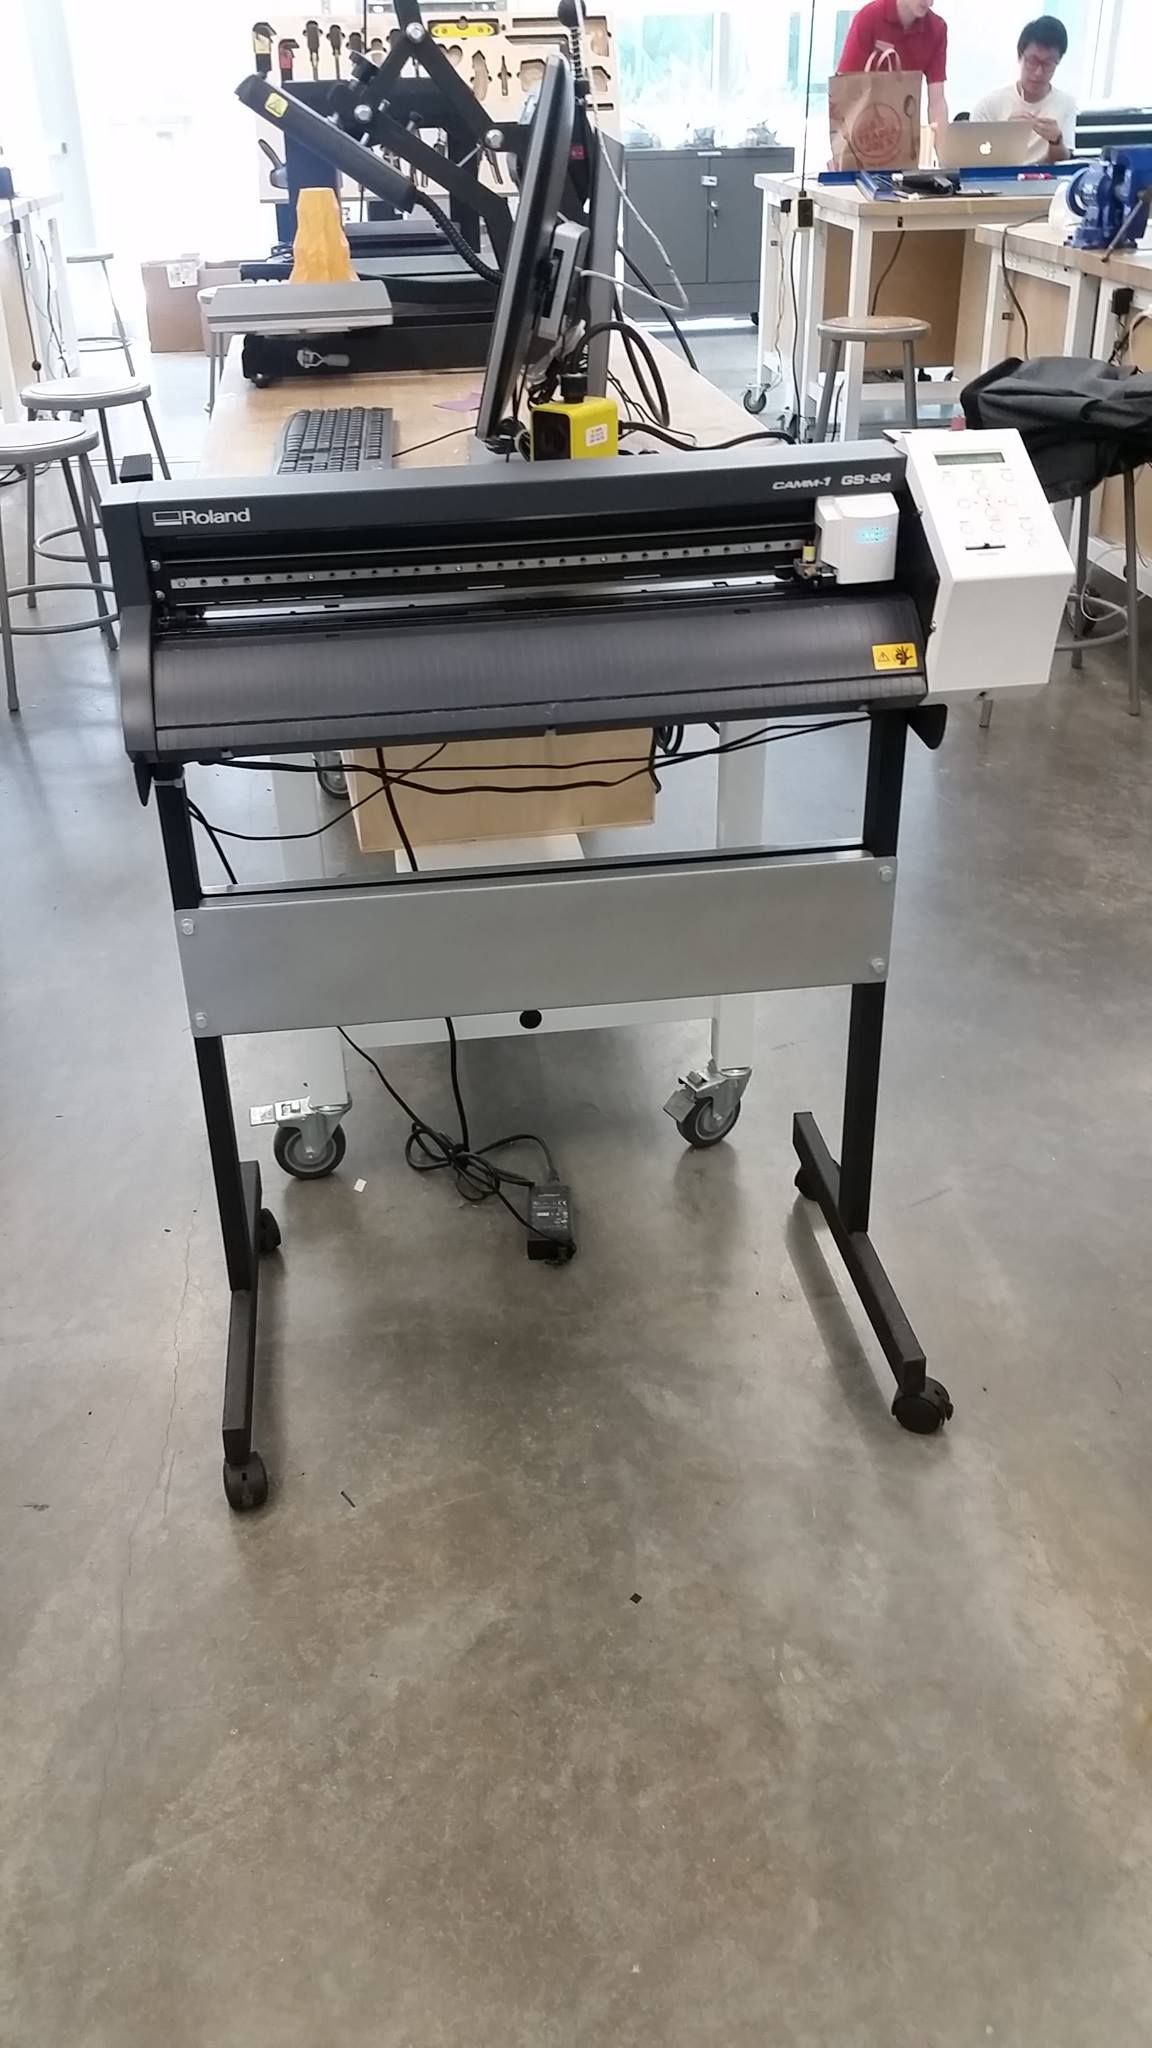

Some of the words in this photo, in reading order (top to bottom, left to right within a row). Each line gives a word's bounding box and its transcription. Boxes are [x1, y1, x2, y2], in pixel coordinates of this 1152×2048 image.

[772, 476, 831, 490] CAMM-1
[841, 472, 892, 486] GS-24
[182, 507, 251, 525] Roland
